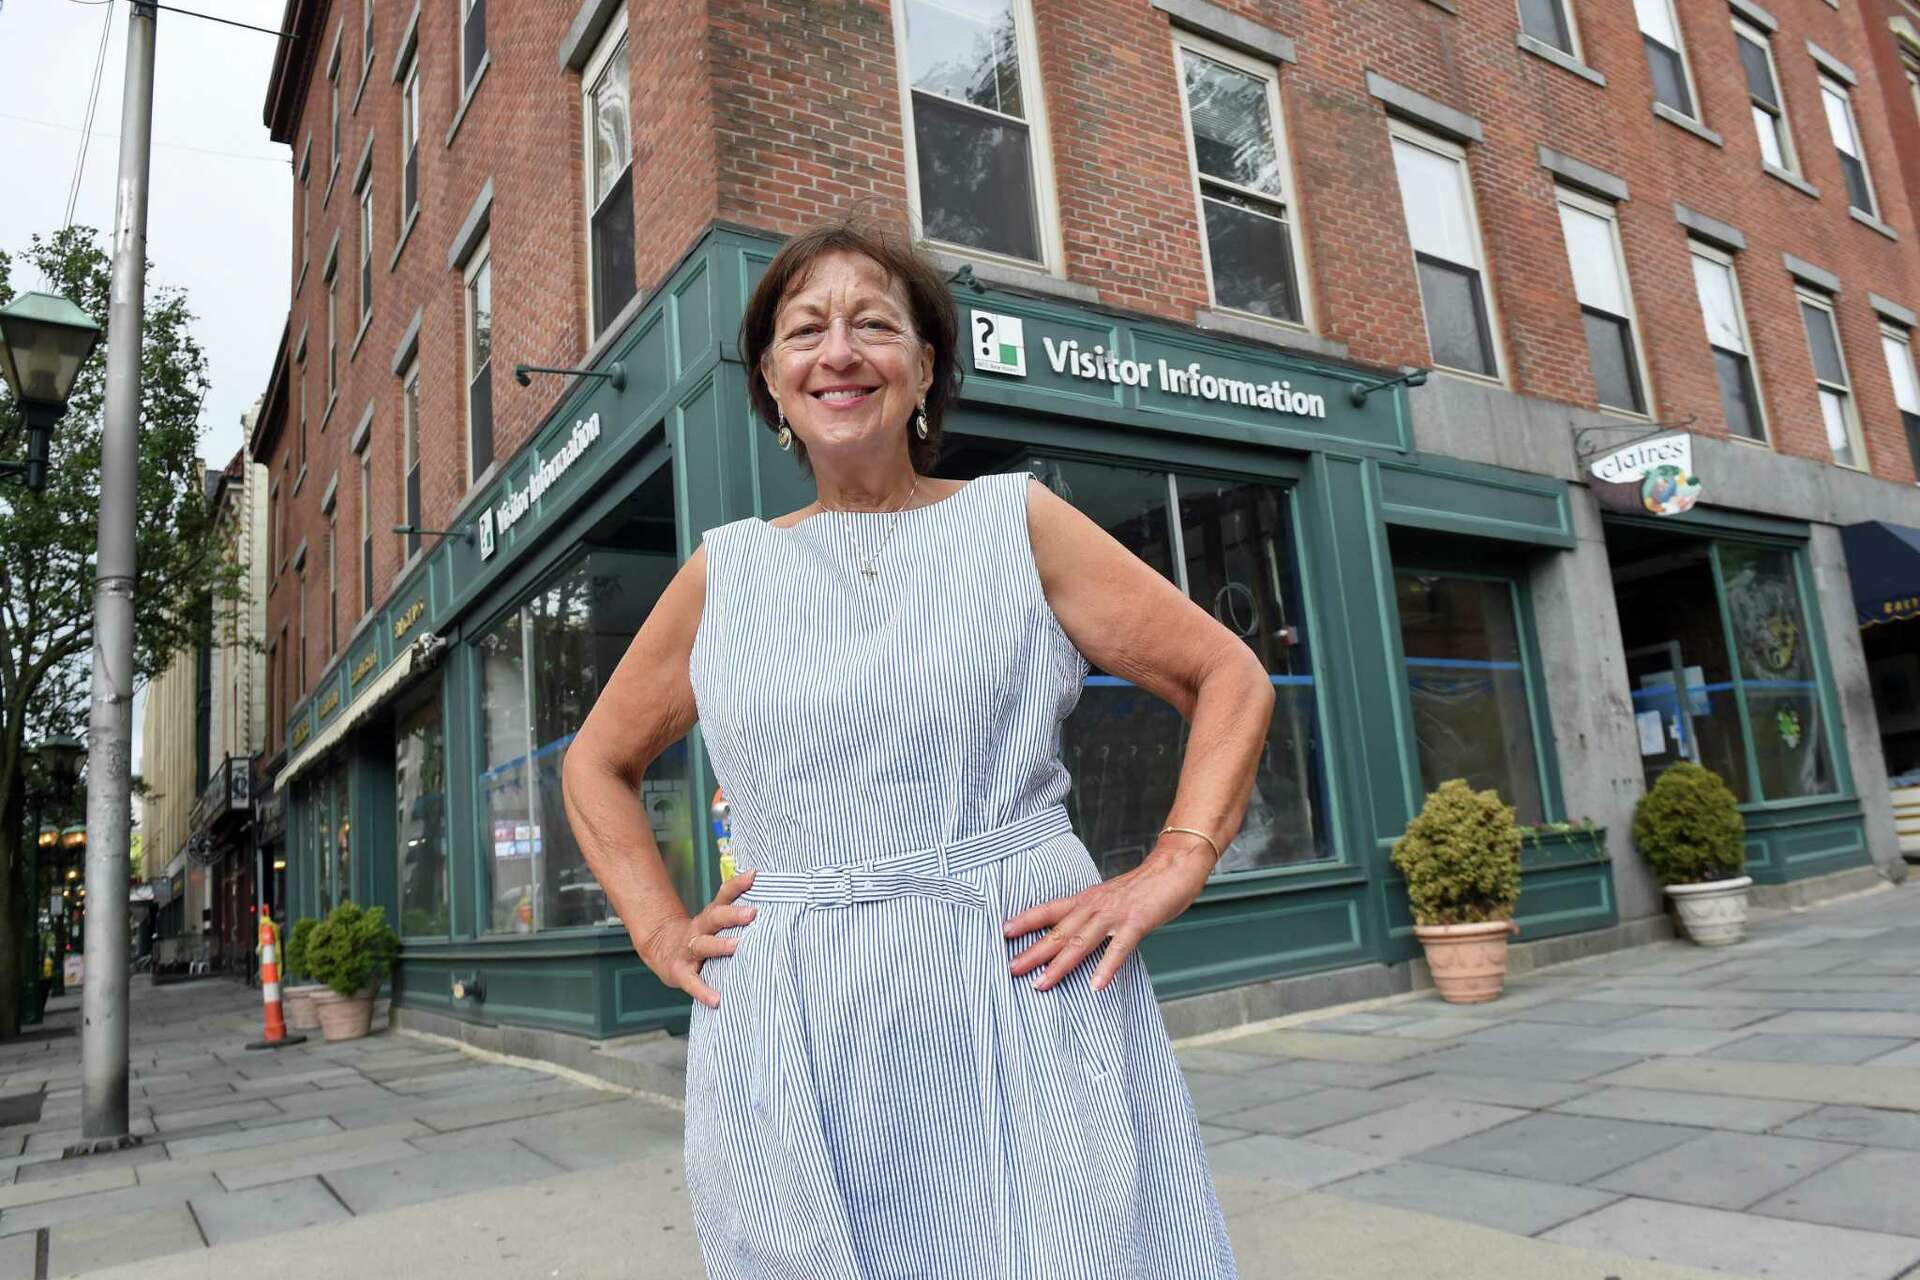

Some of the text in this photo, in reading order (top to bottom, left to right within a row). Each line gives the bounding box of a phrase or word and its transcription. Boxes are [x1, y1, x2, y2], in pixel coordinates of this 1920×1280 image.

[1042, 337, 1326, 418] Visitor Information
[529, 412, 600, 504] Information
